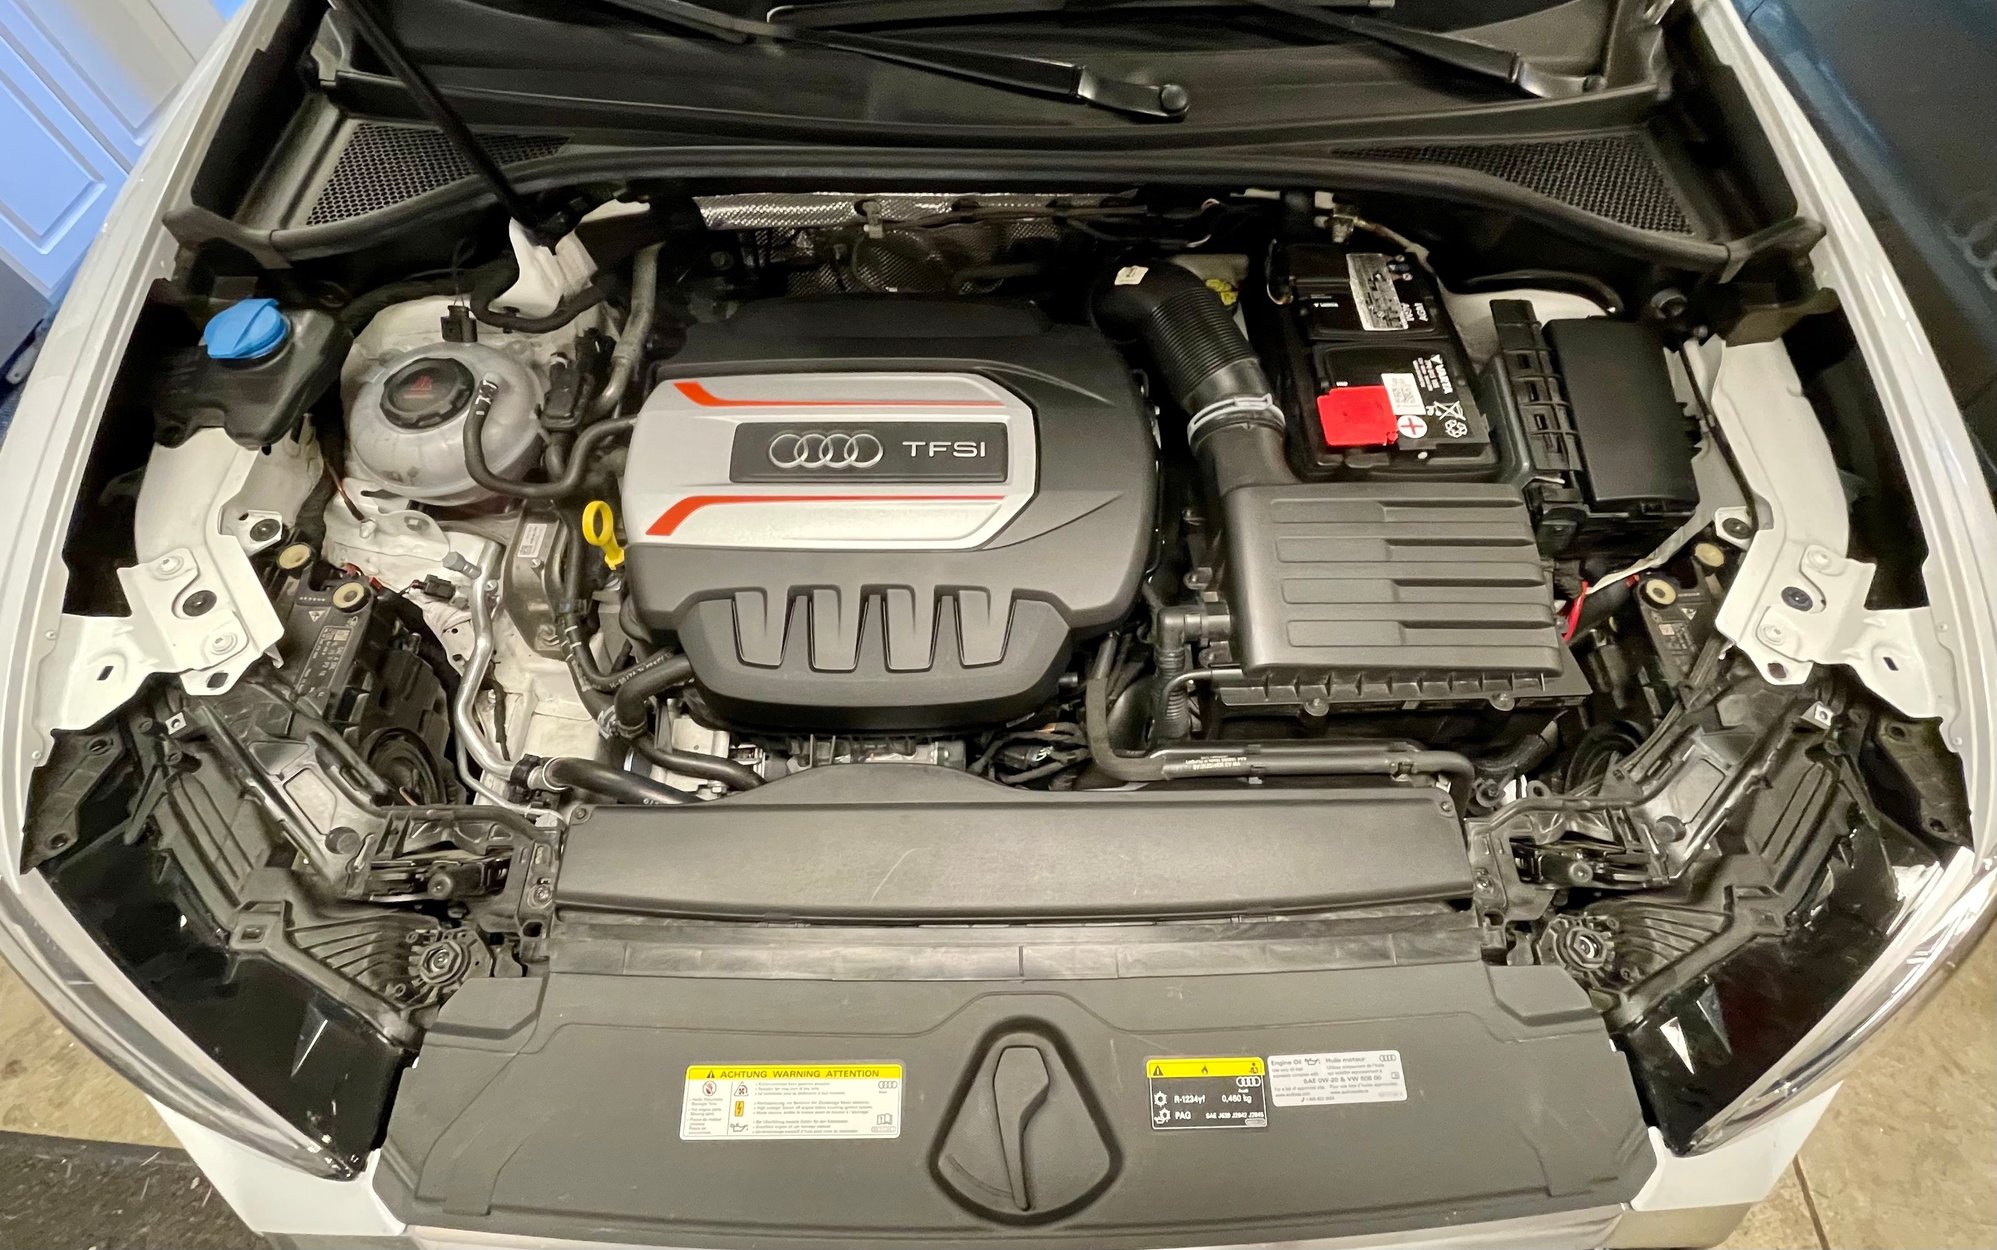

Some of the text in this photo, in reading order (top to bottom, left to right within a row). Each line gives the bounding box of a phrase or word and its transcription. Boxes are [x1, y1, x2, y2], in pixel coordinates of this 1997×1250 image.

[902, 441, 986, 458] TFSI
[720, 1069, 880, 1078] ACHTUNG WARNING ATTENTION
[1174, 1095, 1205, 1104] R-1234yf
[1243, 1094, 1252, 1104] kg
[1175, 1111, 1191, 1120] PAG
